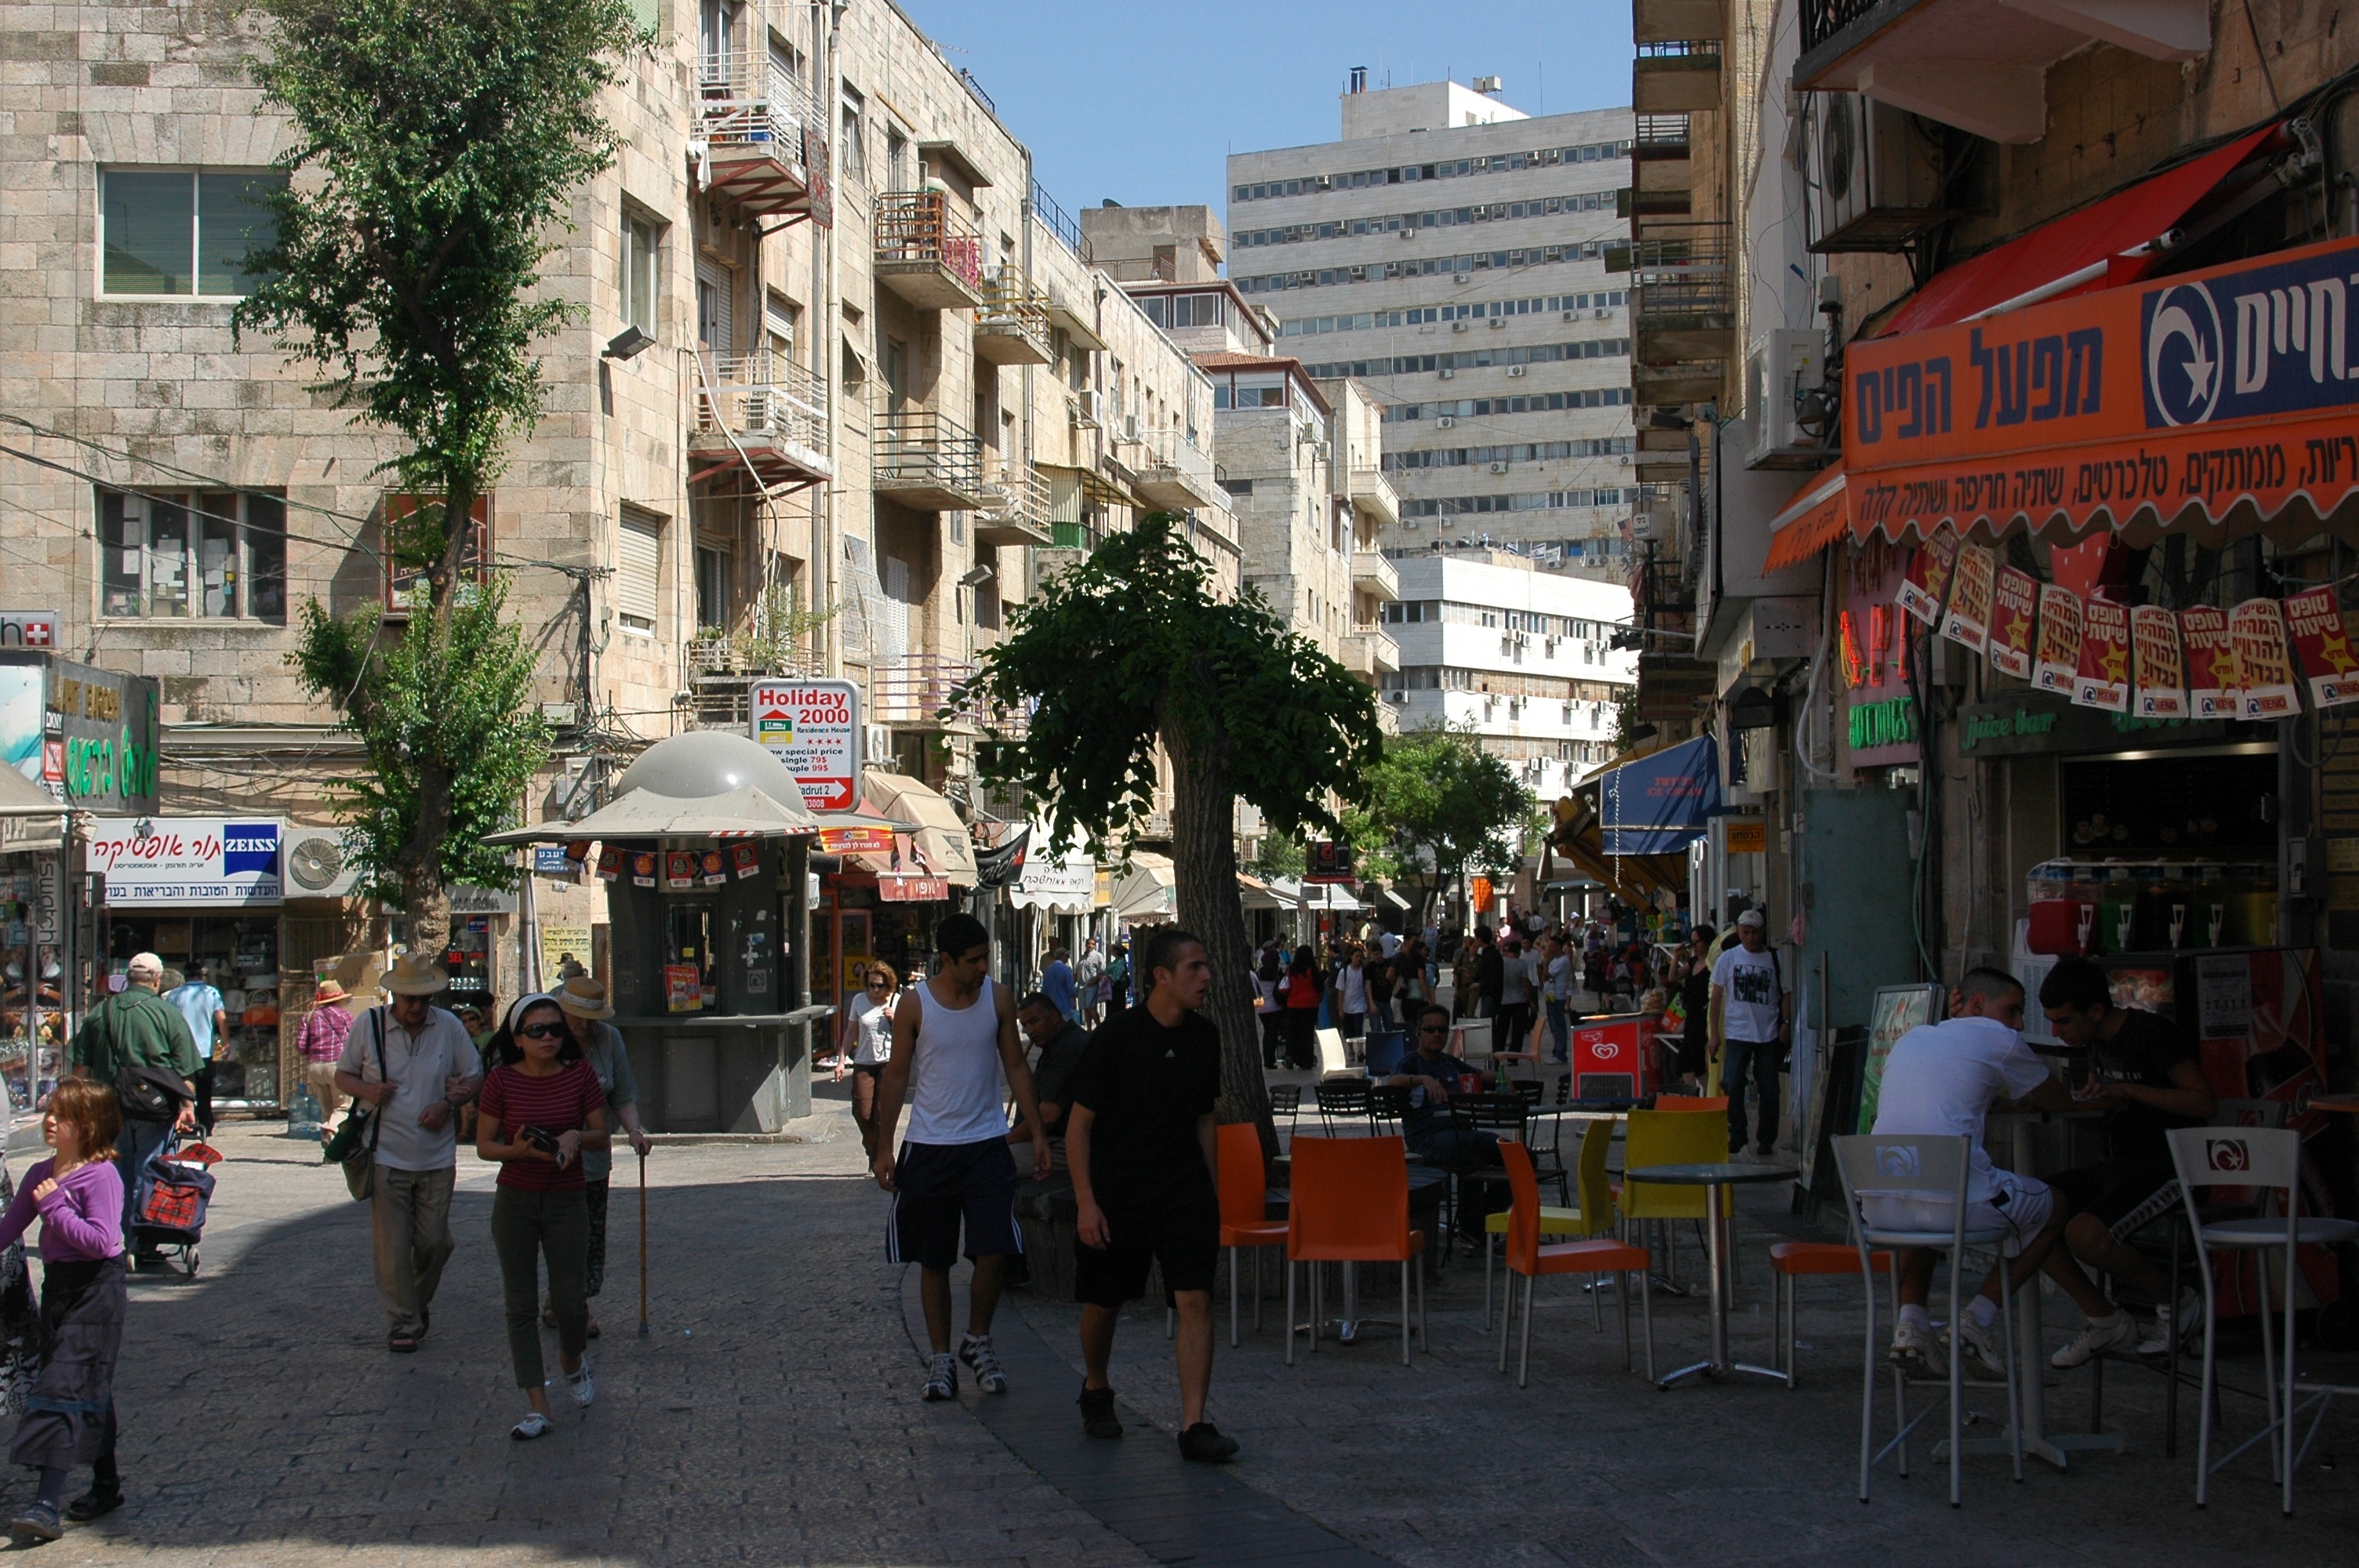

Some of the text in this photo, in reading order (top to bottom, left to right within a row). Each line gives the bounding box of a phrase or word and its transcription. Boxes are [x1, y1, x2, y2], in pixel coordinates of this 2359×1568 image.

[2235, 274, 2359, 394] חיים
[1856, 327, 2103, 445] מפעל הפיס
[2299, 436, 2359, 488] ריות,
[2179, 443, 2286, 506] ממתקים,
[1898, 479, 1948, 517] ושתיה
[1954, 473, 2007, 513] חריפה
[2013, 467, 2064, 508] שתיה
[1859, 479, 1897, 524] קלה
[1933, 527, 1956, 546] טופ
[1922, 539, 1954, 567] שיטת
[2002, 572, 2031, 597] טופס
[1997, 589, 2033, 616] שיטתי
[2043, 600, 2081, 626] המהירה
[2288, 593, 2328, 619] טופס
[2088, 604, 2123, 626] טופס
[2183, 612, 2223, 631] טופס
[2288, 613, 2340, 638] שיטתי
[1961, 628, 1982, 644] KENO
[2084, 622, 2127, 644] שיטתי
[2135, 622, 2176, 644] המהירה
[2232, 619, 2281, 637] המהירה
[2047, 630, 2077, 669] בגדול
[2184, 630, 2231, 649] שיטתי
[2001, 654, 2020, 670] KENO
[2143, 655, 2177, 688] בגדול
[2241, 654, 2284, 684] בגדול
[2055, 674, 2074, 690] KENO
[2337, 683, 2359, 694] KENO
[759, 689, 846, 709] Holiday
[2097, 691, 2120, 702] KENO
[2156, 699, 2178, 710] KENO
[2261, 698, 2287, 709] KENO
[46, 712, 63, 729] DKNY
[799, 709, 849, 724] 2000
[1961, 713, 2011, 750] juice
[781, 757, 808, 766] single
[786, 748, 817, 757] special
[820, 748, 843, 757] price
[799, 786, 830, 795] adrut 2
[94, 834, 220, 871] תור אופטיקה
[226, 839, 275, 852] ZEISS
[106, 885, 278, 898] העדשות הטובות והבריאות בעו
